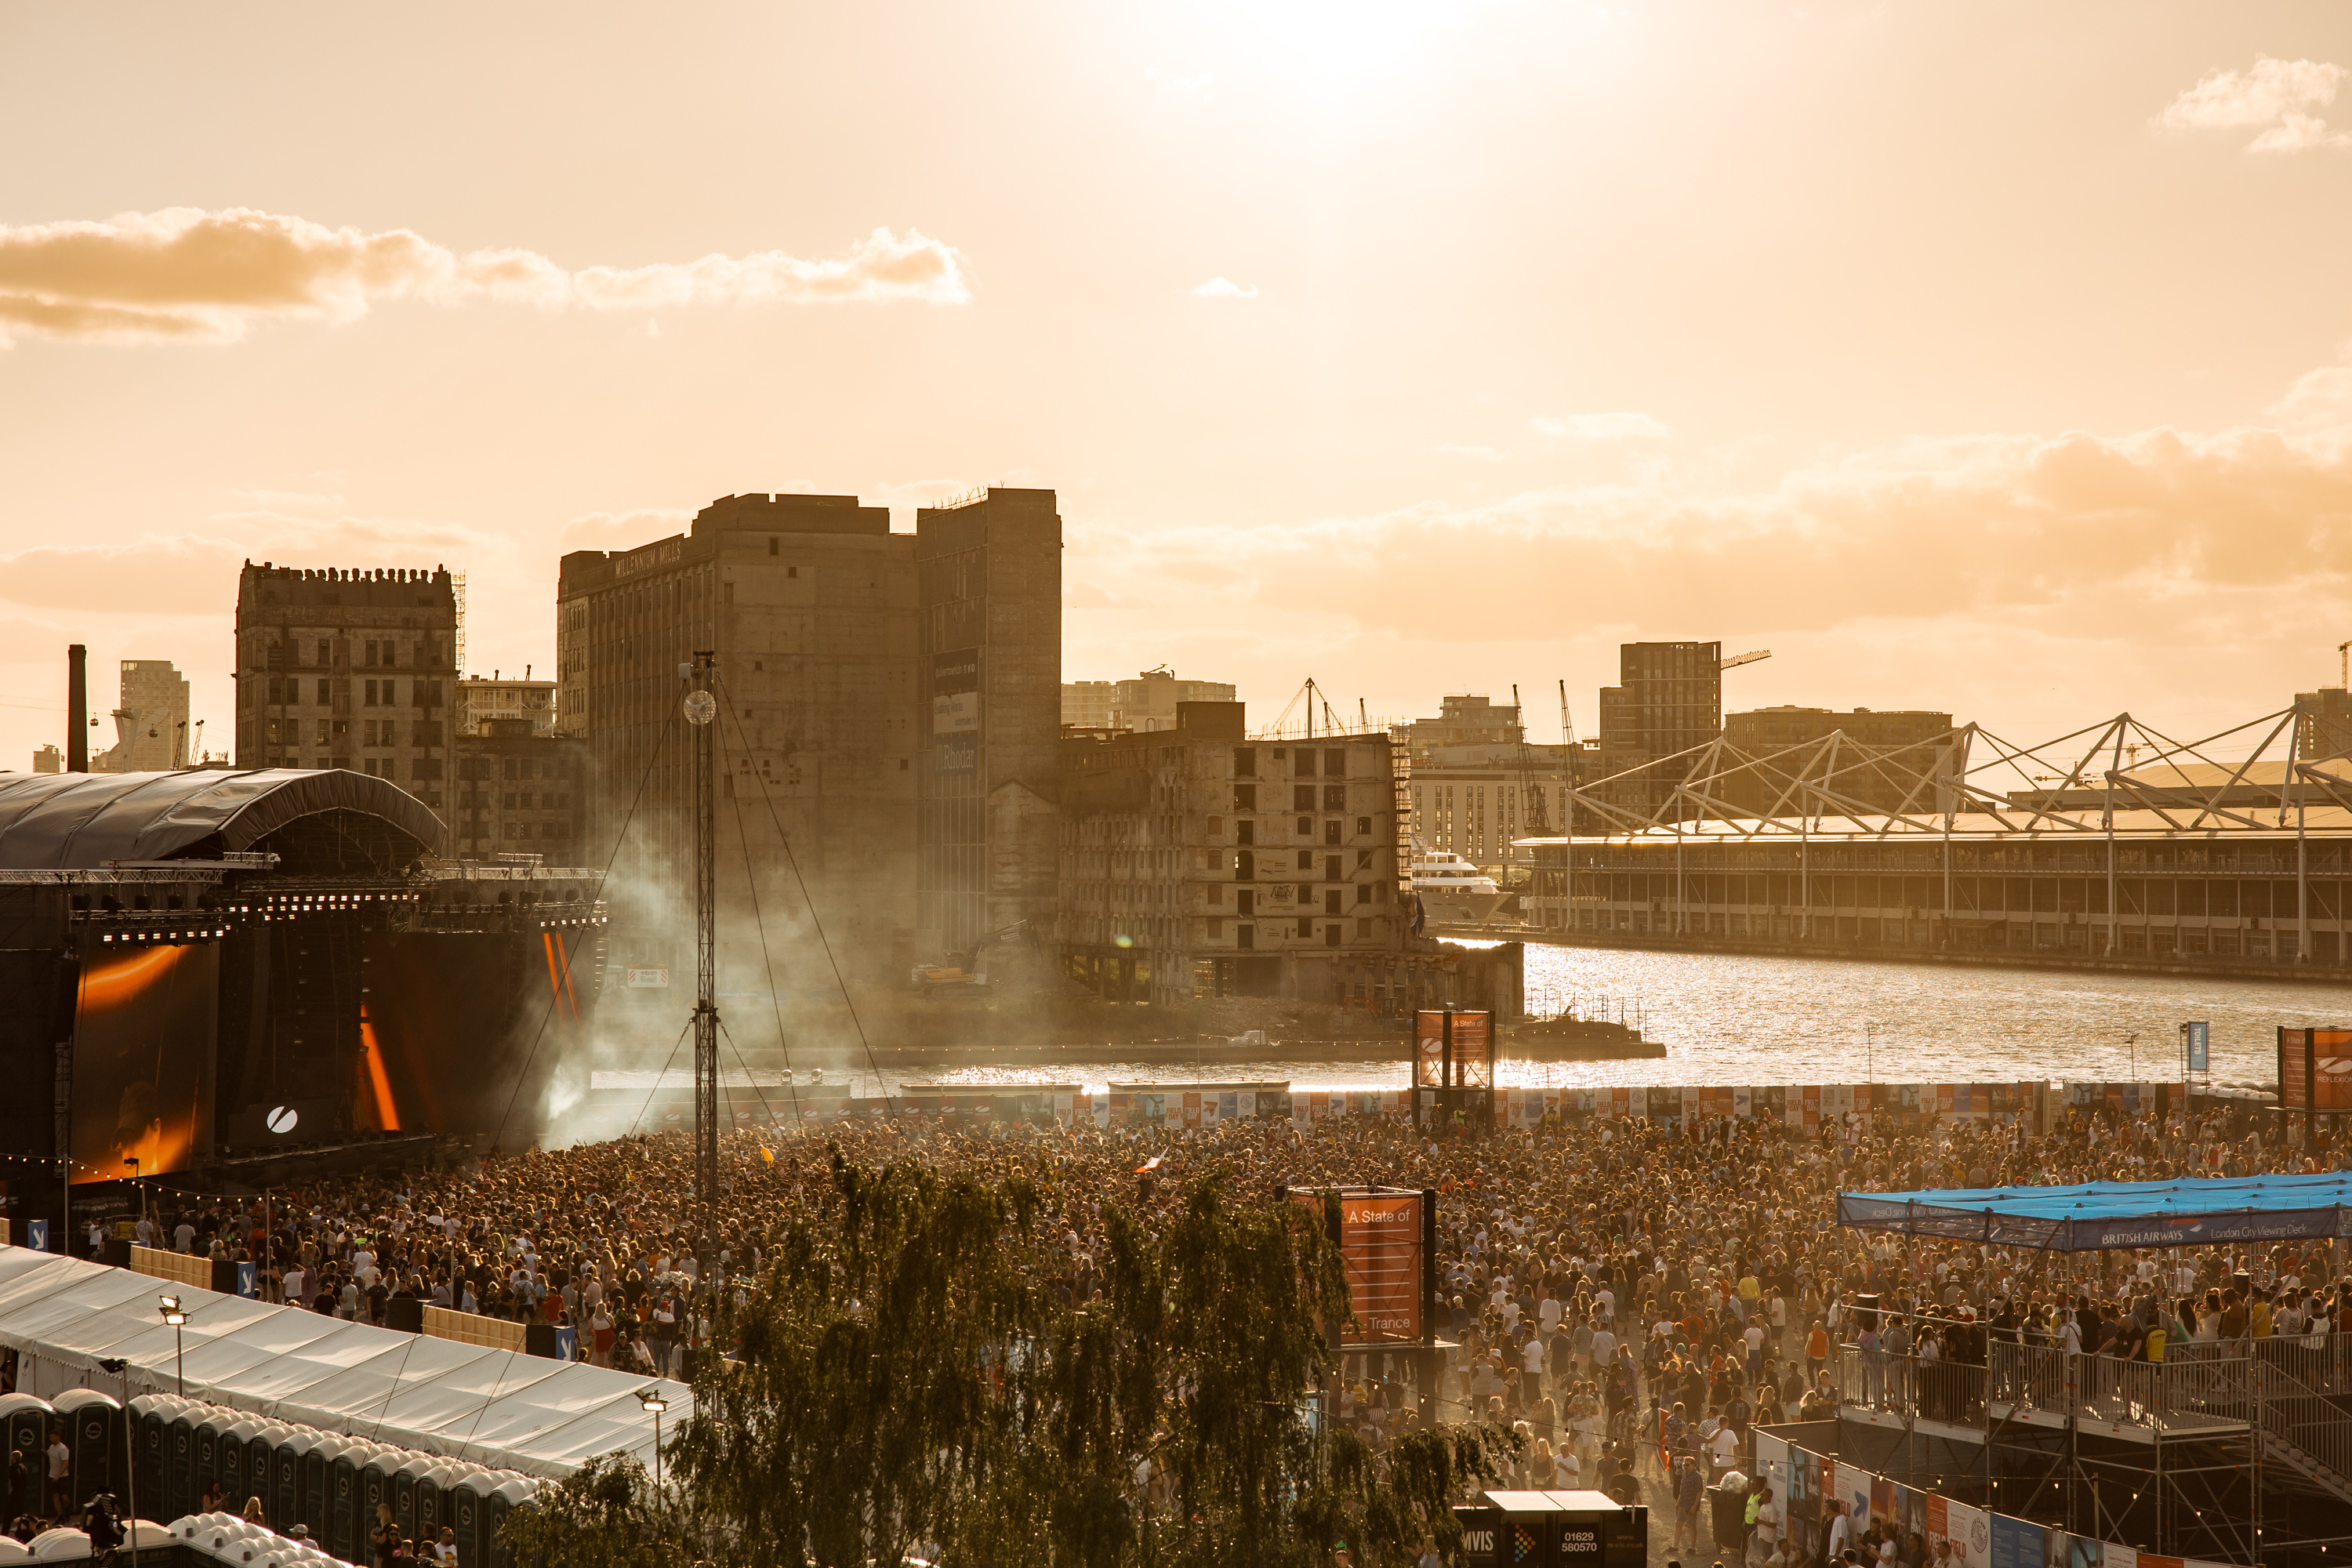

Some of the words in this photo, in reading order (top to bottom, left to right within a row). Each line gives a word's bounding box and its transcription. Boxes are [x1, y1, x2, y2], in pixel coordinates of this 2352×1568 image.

[615, 549, 655, 579] MILLENNIUM
[659, 541, 681, 565] MILLS
[943, 742, 975, 770] Rhodar
[1348, 1211, 1358, 1223] A
[1362, 1210, 1394, 1223] State
[1397, 1209, 1410, 1222] of
[2102, 1232, 2140, 1244] BRITISH
[2143, 1229, 2183, 1242] AIRWAYS
[2211, 1228, 2240, 1238] London
[2241, 1226, 2256, 1238] City
[2257, 1225, 2286, 1237] Viewing
[2287, 1224, 2307, 1234] Deck
[1369, 1317, 1410, 1330] Trance
[1564, 1532, 1594, 1541] 01629
[1561, 1542, 1597, 1552] 580570
[1950, 1538, 1966, 1559] FIELD
